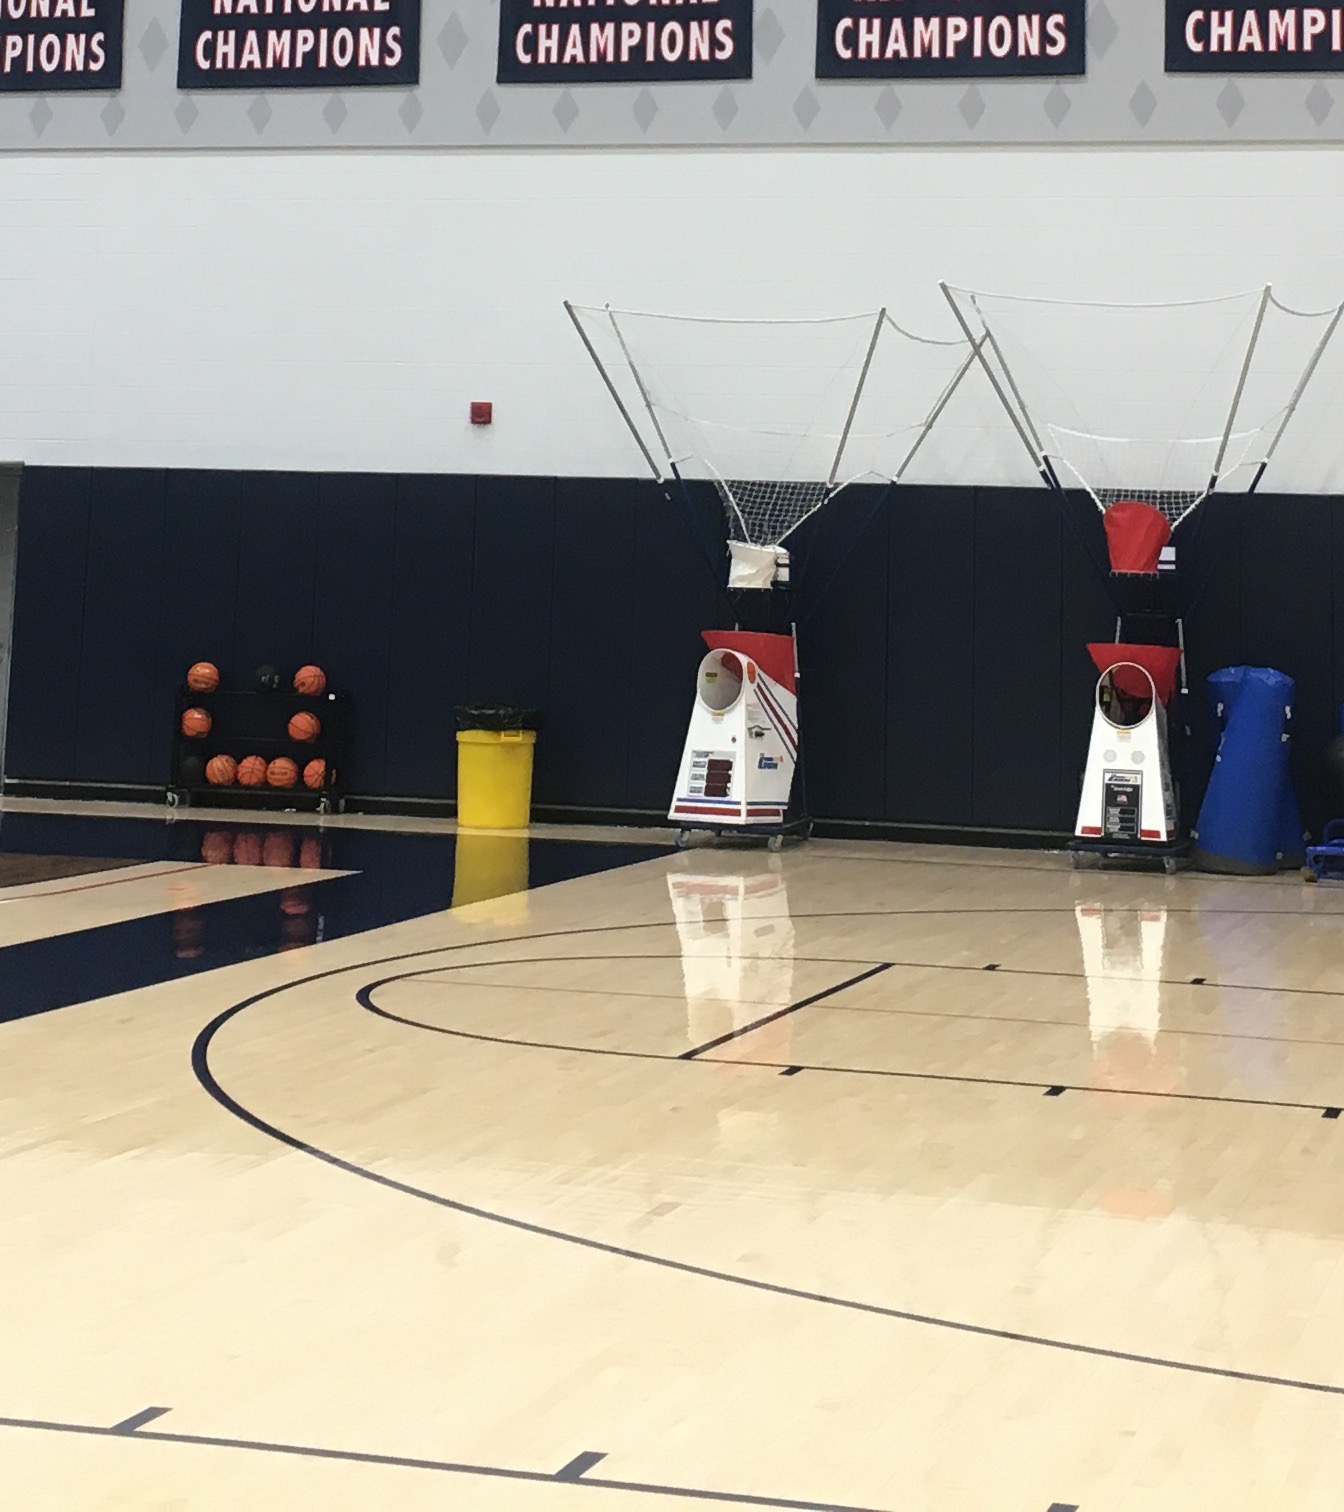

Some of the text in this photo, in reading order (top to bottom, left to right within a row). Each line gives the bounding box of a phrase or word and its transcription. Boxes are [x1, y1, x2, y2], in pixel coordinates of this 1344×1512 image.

[195, 25, 403, 70] CHAMPIONS
[515, 18, 735, 65] CHAMPIONS
[834, 13, 1067, 60] CHAMPIONS
